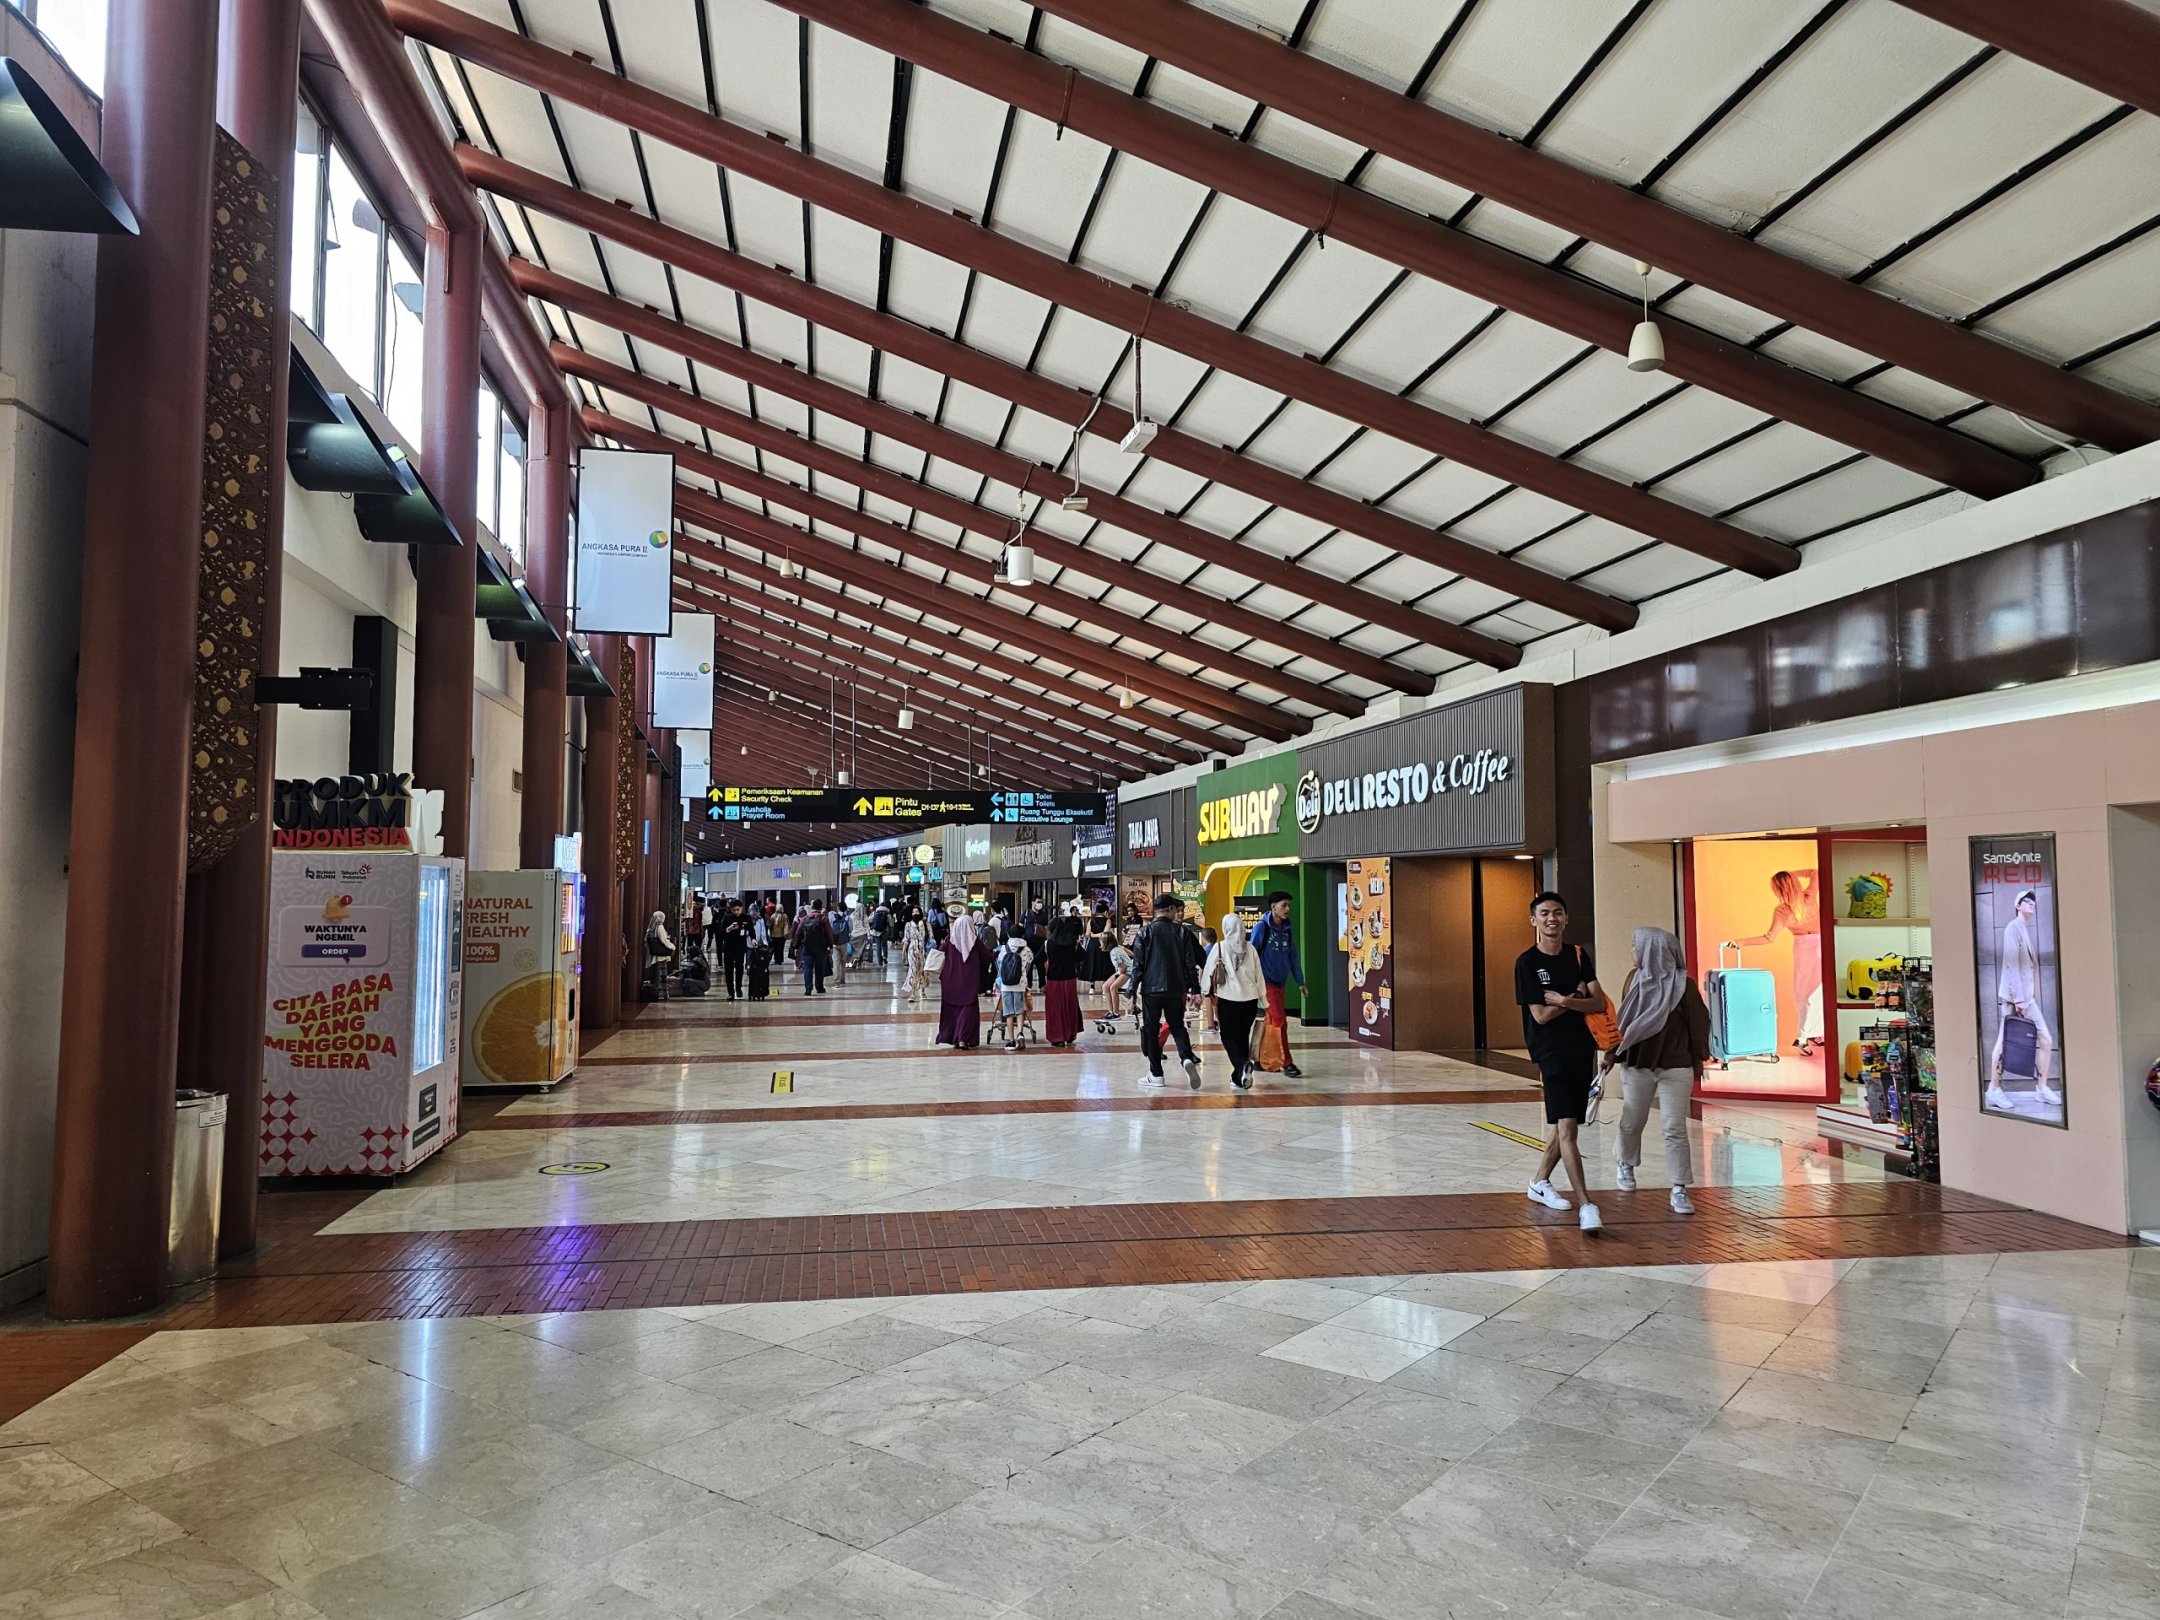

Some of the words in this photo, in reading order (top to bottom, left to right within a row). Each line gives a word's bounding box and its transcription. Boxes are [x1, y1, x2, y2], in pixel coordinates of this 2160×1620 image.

[582, 543, 619, 551] ANGKASA
[620, 544, 641, 552] PURA
[274, 772, 412, 800] PRODUK
[1324, 776, 1360, 816] DELI
[1363, 762, 1429, 810] RESTO
[1432, 760, 1446, 794] &
[1450, 748, 1508, 795] Coffee
[741, 787, 786, 795] Pemeriksaan
[786, 788, 824, 796] Keamanan
[1035, 792, 1053, 800] Toilet
[741, 795, 769, 803] Security
[770, 795, 792, 803] Check
[895, 797, 918, 806] Pintu
[1299, 788, 1319, 821] Deli
[273, 798, 406, 829] UMKM
[894, 807, 922, 816] Gates
[1020, 808, 1041, 816] Ruang
[1041, 808, 1064, 816] Tunggu
[1065, 808, 1094, 816] Eksekutif
[1197, 783, 1280, 846] SUBWAY
[1020, 815, 1049, 823] Executive
[1050, 815, 1074, 824] Lounge
[1983, 852, 2041, 865] Samsonite
[1983, 864, 2042, 884] RED
[467, 912, 509, 924] RESH
[304, 925, 367, 933] WAKTUNYA
[315, 933, 356, 941] NGEMIL
[273, 991, 327, 1011] CITA
[331, 973, 393, 1001] RASA
[286, 994, 380, 1024] DAERAH
[299, 1015, 366, 1038] YANG
[264, 1033, 398, 1057] MENGGODA
[290, 1053, 370, 1071] SELERA
